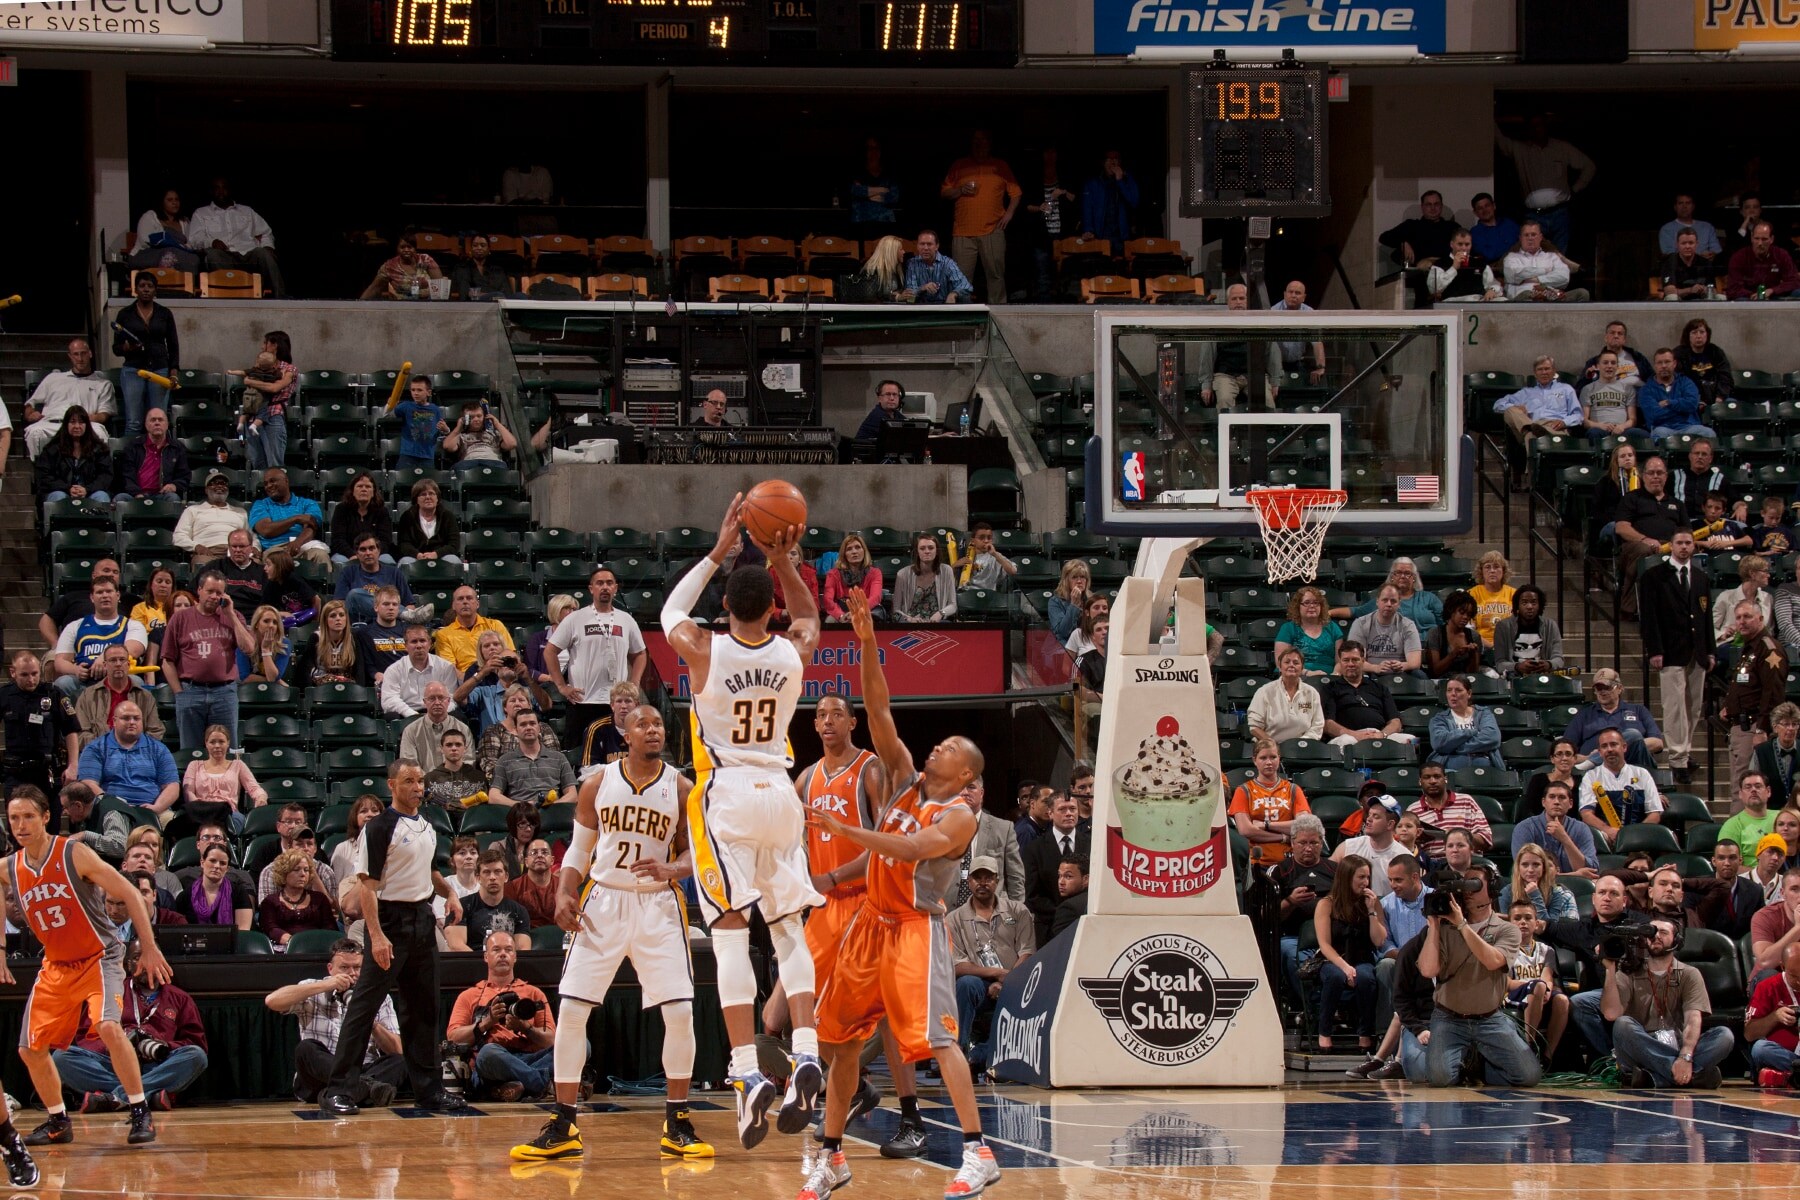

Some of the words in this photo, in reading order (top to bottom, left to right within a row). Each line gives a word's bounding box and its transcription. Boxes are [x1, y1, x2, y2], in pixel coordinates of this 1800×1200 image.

[640, 23, 688, 40] PERIOD
[709, 16, 729, 48] 4
[1215, 81, 1281, 120] 19.9
[1328, 77, 1344, 97] XIT
[1590, 391, 1628, 405] PURDUE
[803, 432, 832, 441] YAMAHA
[1125, 490, 1138, 498] NBA
[724, 668, 788, 695] GRANGER
[1135, 668, 1199, 684] SPALDING
[730, 697, 777, 745] 33
[1252, 796, 1290, 811] PHX
[600, 805, 671, 842] PACERS
[615, 841, 642, 870] 21
[1122, 844, 1150, 876] 1/2
[1155, 844, 1215, 878] PRICE
[1121, 868, 1169, 894] HAPPY
[1172, 868, 1215, 894] HOUR!
[21, 882, 72, 912] PHX
[34, 905, 67, 932] 13
[1126, 937, 1181, 963] FAMOUS
[1184, 942, 1210, 964] FOR
[1133, 963, 1204, 992] Steak
[1131, 1002, 1206, 1030] Shake
[991, 1006, 1048, 1076] SPALDING
[1120, 1032, 1216, 1063] STEAKBURGERS
